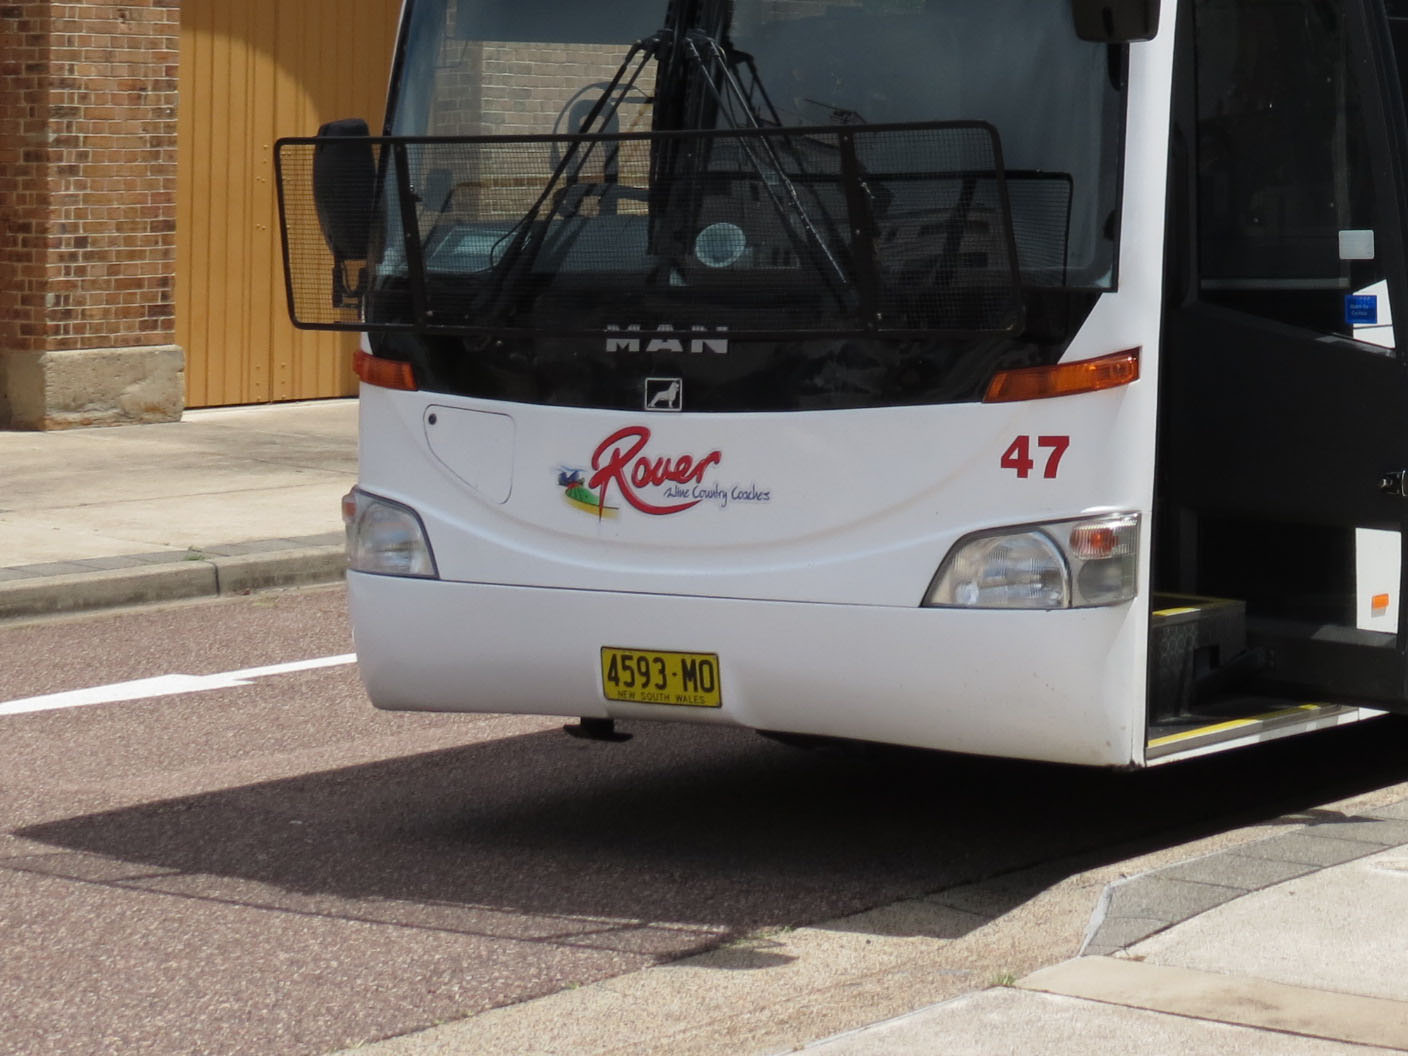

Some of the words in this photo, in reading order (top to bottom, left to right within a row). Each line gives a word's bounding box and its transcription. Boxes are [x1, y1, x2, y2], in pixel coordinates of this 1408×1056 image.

[606, 323, 728, 354] MAN
[1000, 435, 1070, 479] 47
[588, 425, 722, 522] Rover
[663, 484, 691, 499] Wine
[692, 483, 728, 508] Country
[731, 483, 770, 501] Coaches
[617, 689, 636, 700] NEW
[640, 692, 671, 703] SOUTH
[675, 694, 706, 705] WALES
